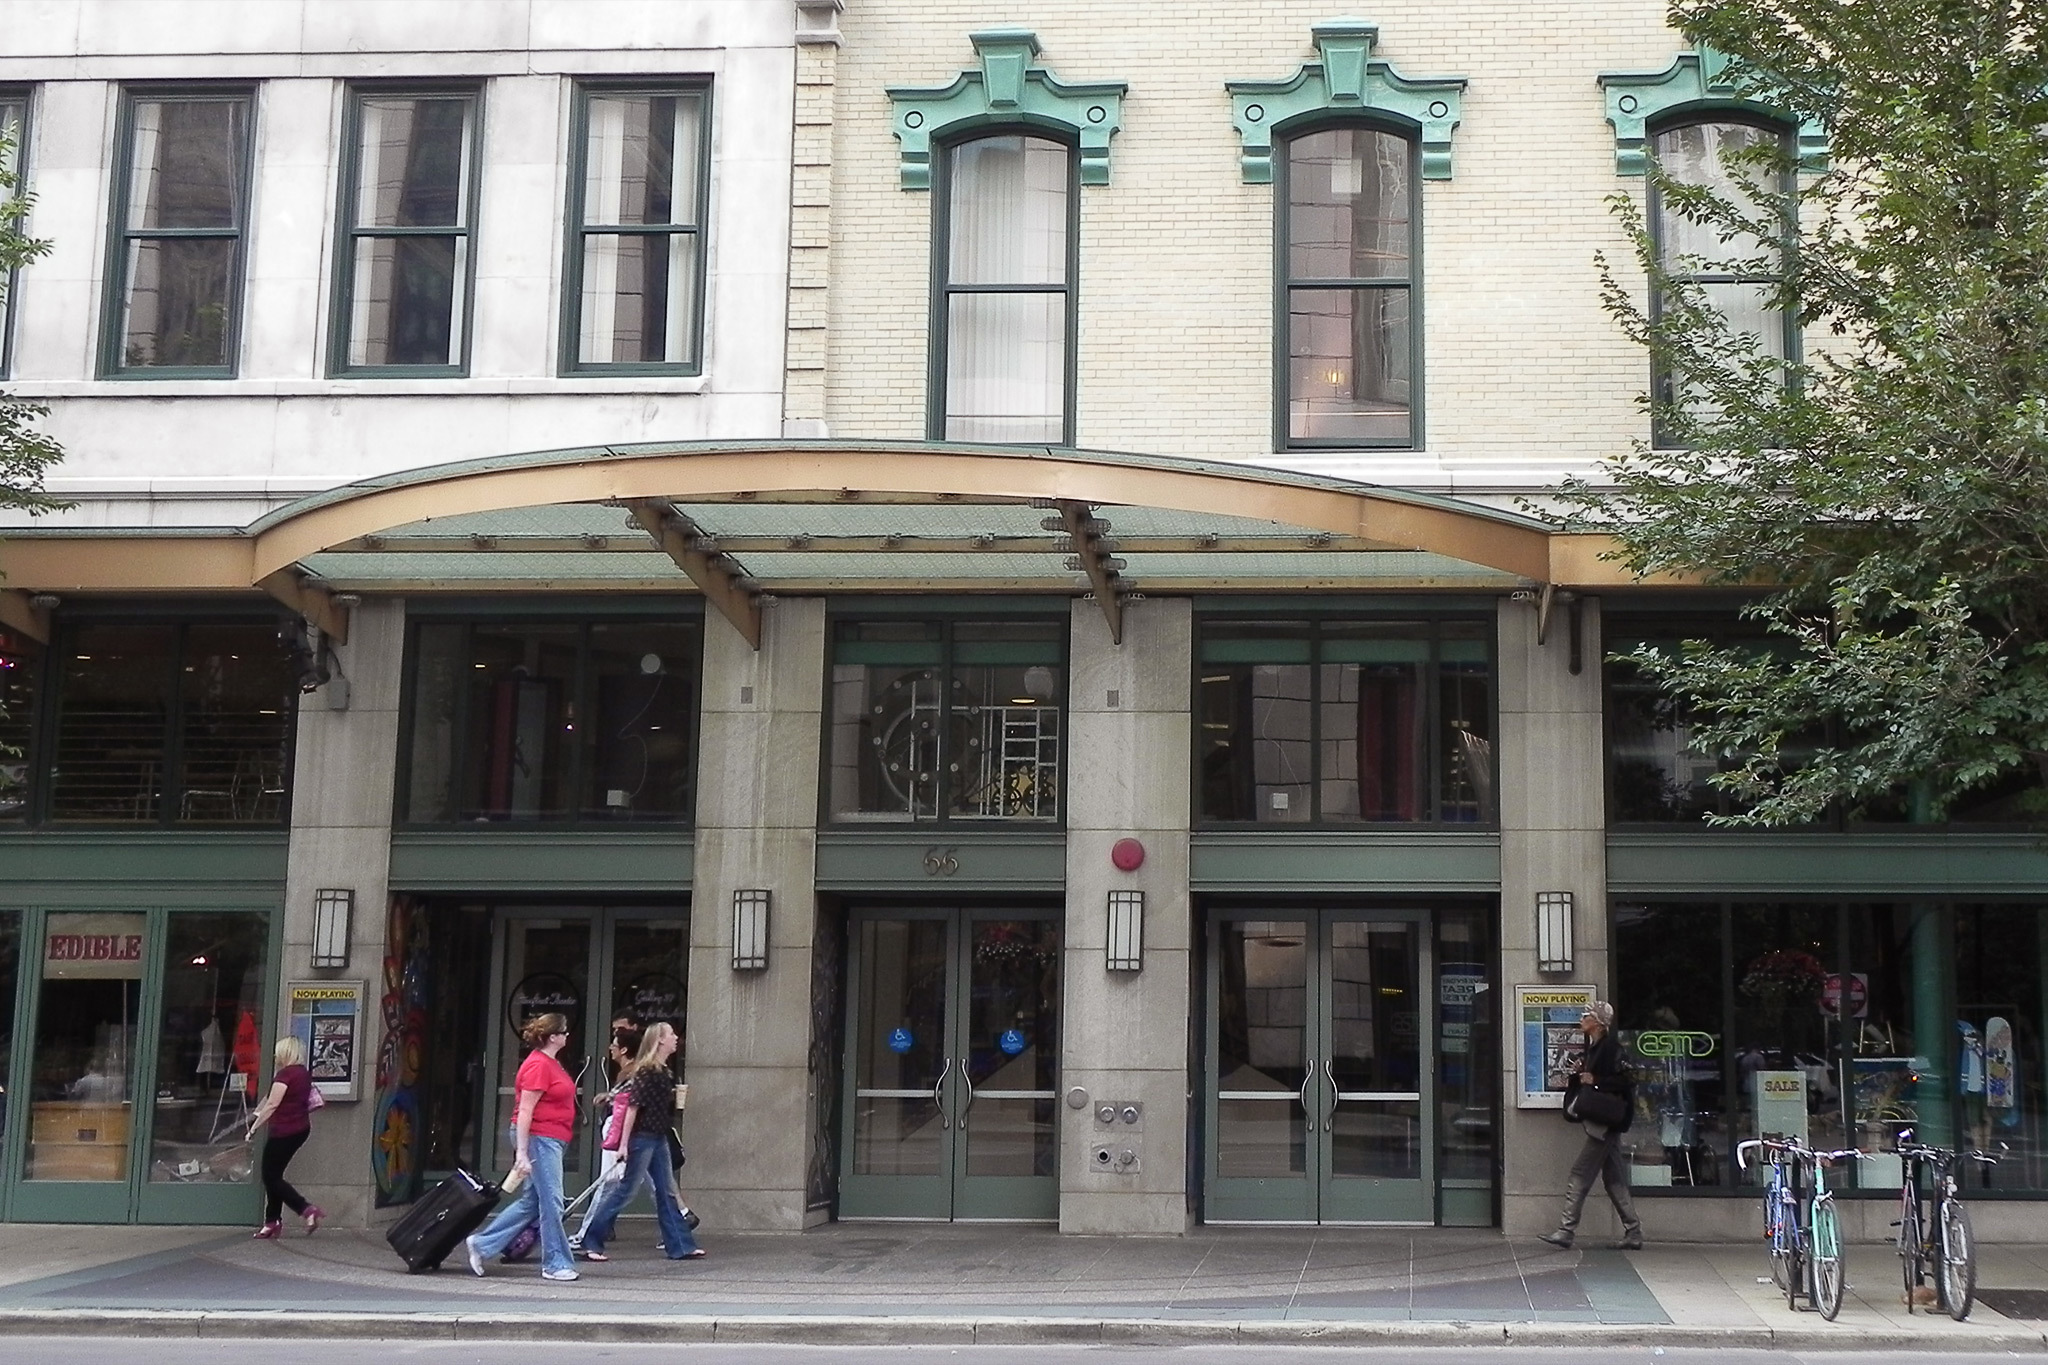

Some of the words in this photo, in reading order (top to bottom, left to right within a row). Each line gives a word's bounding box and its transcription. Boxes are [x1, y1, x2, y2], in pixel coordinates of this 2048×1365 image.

[923, 848, 959, 876] 66
[48, 935, 142, 960] EDIBLE
[296, 990, 318, 998] NOW
[320, 990, 354, 998] PLAYING
[1643, 1035, 1693, 1054] asm
[1765, 1081, 1799, 1091] SALE
